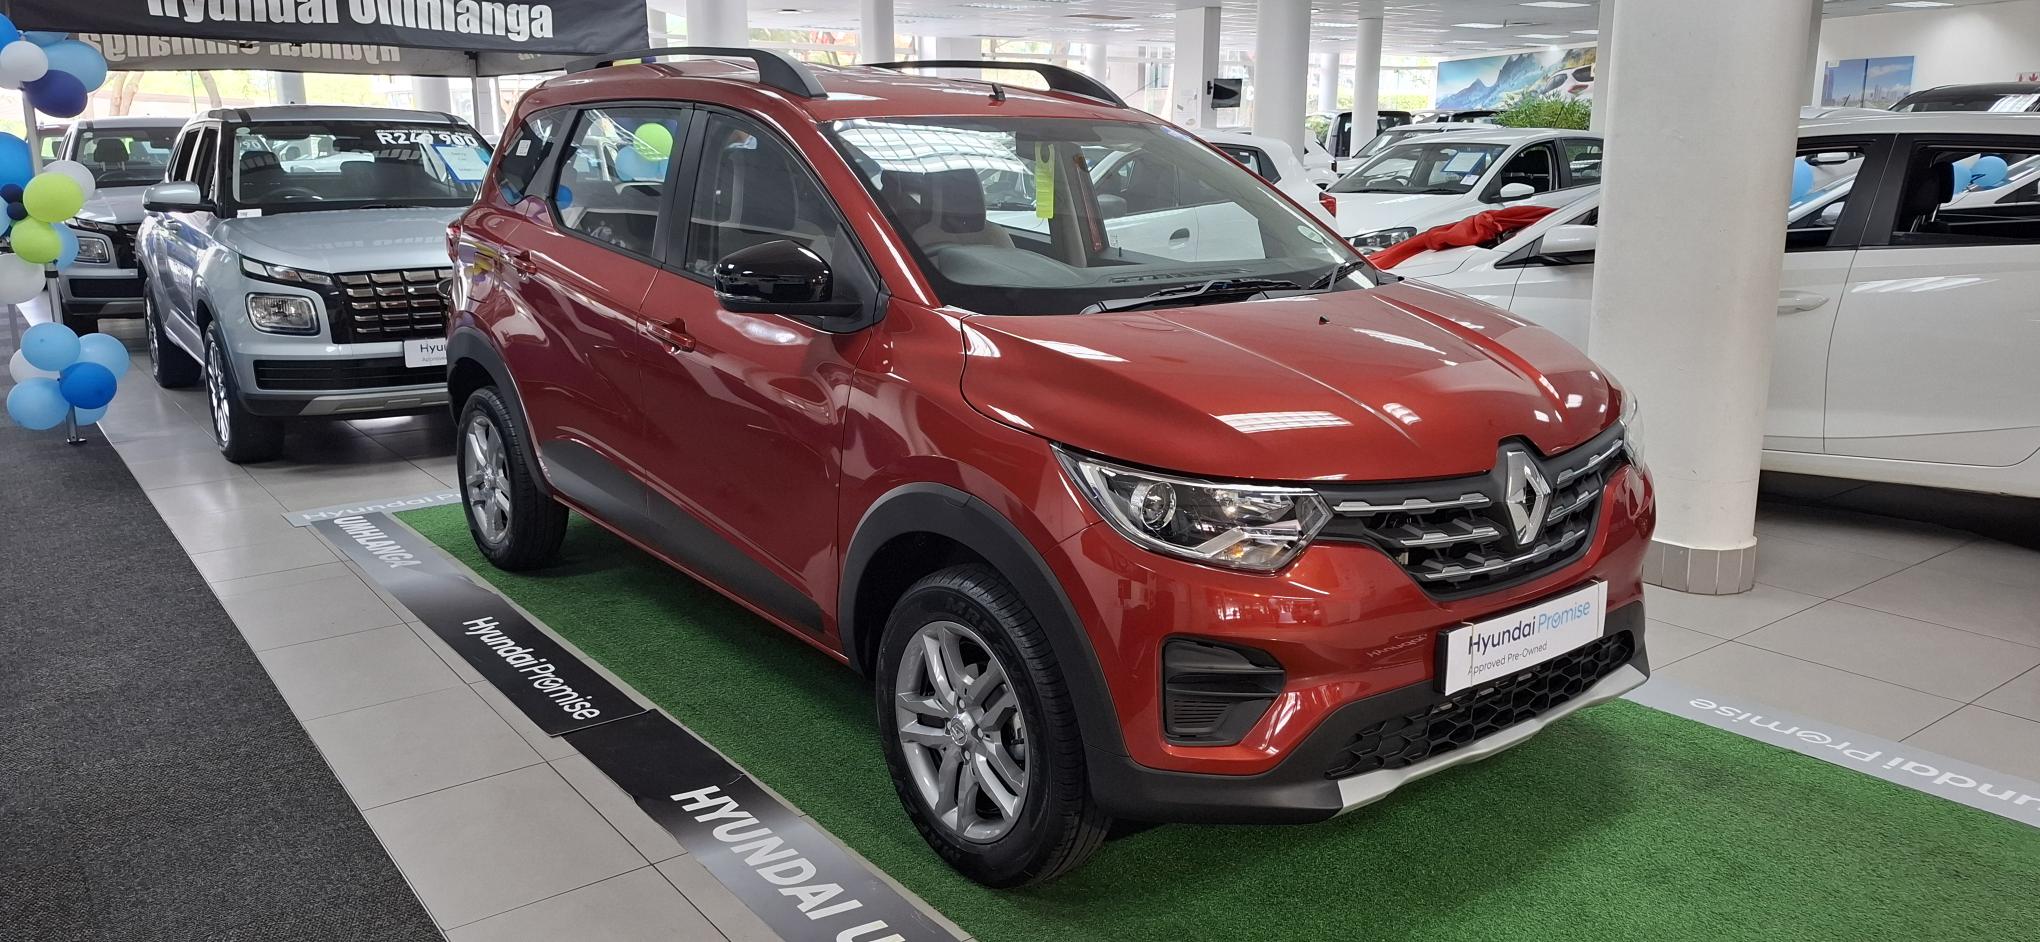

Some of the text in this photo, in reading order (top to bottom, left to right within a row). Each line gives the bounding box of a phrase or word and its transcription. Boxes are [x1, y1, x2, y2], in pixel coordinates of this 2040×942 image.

[439, 134, 479, 147] 900
[420, 344, 447, 354] Hyu
[302, 496, 432, 521] Hyundai
[334, 515, 422, 568] UMHLANGA
[1468, 616, 1536, 656] Hyundai
[1538, 600, 1591, 633] Promise
[462, 616, 600, 720] Hyundai Promise
[1468, 641, 1548, 676] Approved Pre-Owned
[1689, 698, 1882, 762] Promise
[670, 785, 863, 920] HYUNDAI
